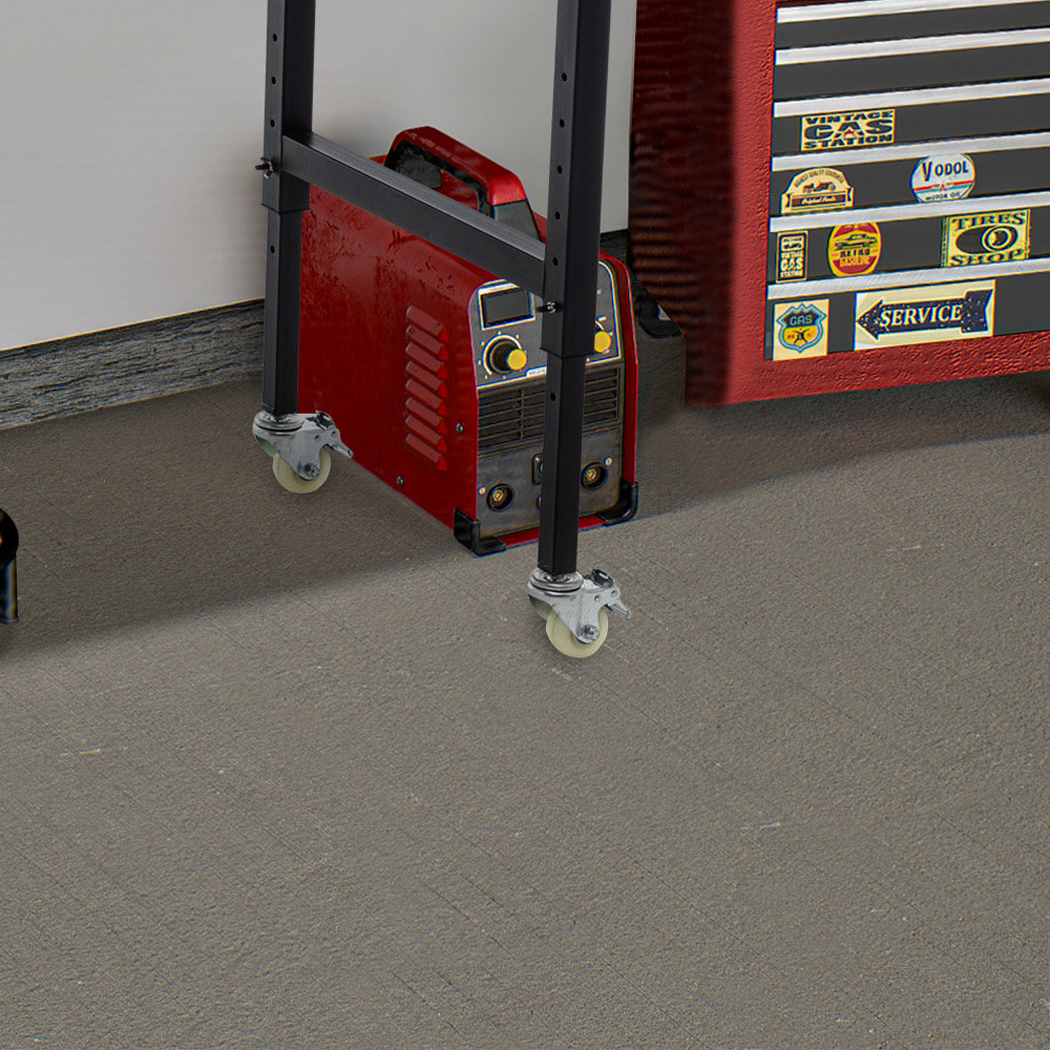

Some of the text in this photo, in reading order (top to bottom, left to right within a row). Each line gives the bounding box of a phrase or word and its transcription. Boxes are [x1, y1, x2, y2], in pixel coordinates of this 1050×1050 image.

[805, 110, 894, 125] VINTAGE
[804, 119, 893, 140] GAS
[804, 134, 893, 149] STATION
[921, 161, 969, 182] VODOL
[951, 211, 1027, 230] TIRES
[780, 258, 804, 271] GAS
[951, 248, 1026, 266] SHOP
[789, 314, 812, 326] GAS
[879, 304, 963, 326] SERVICE
